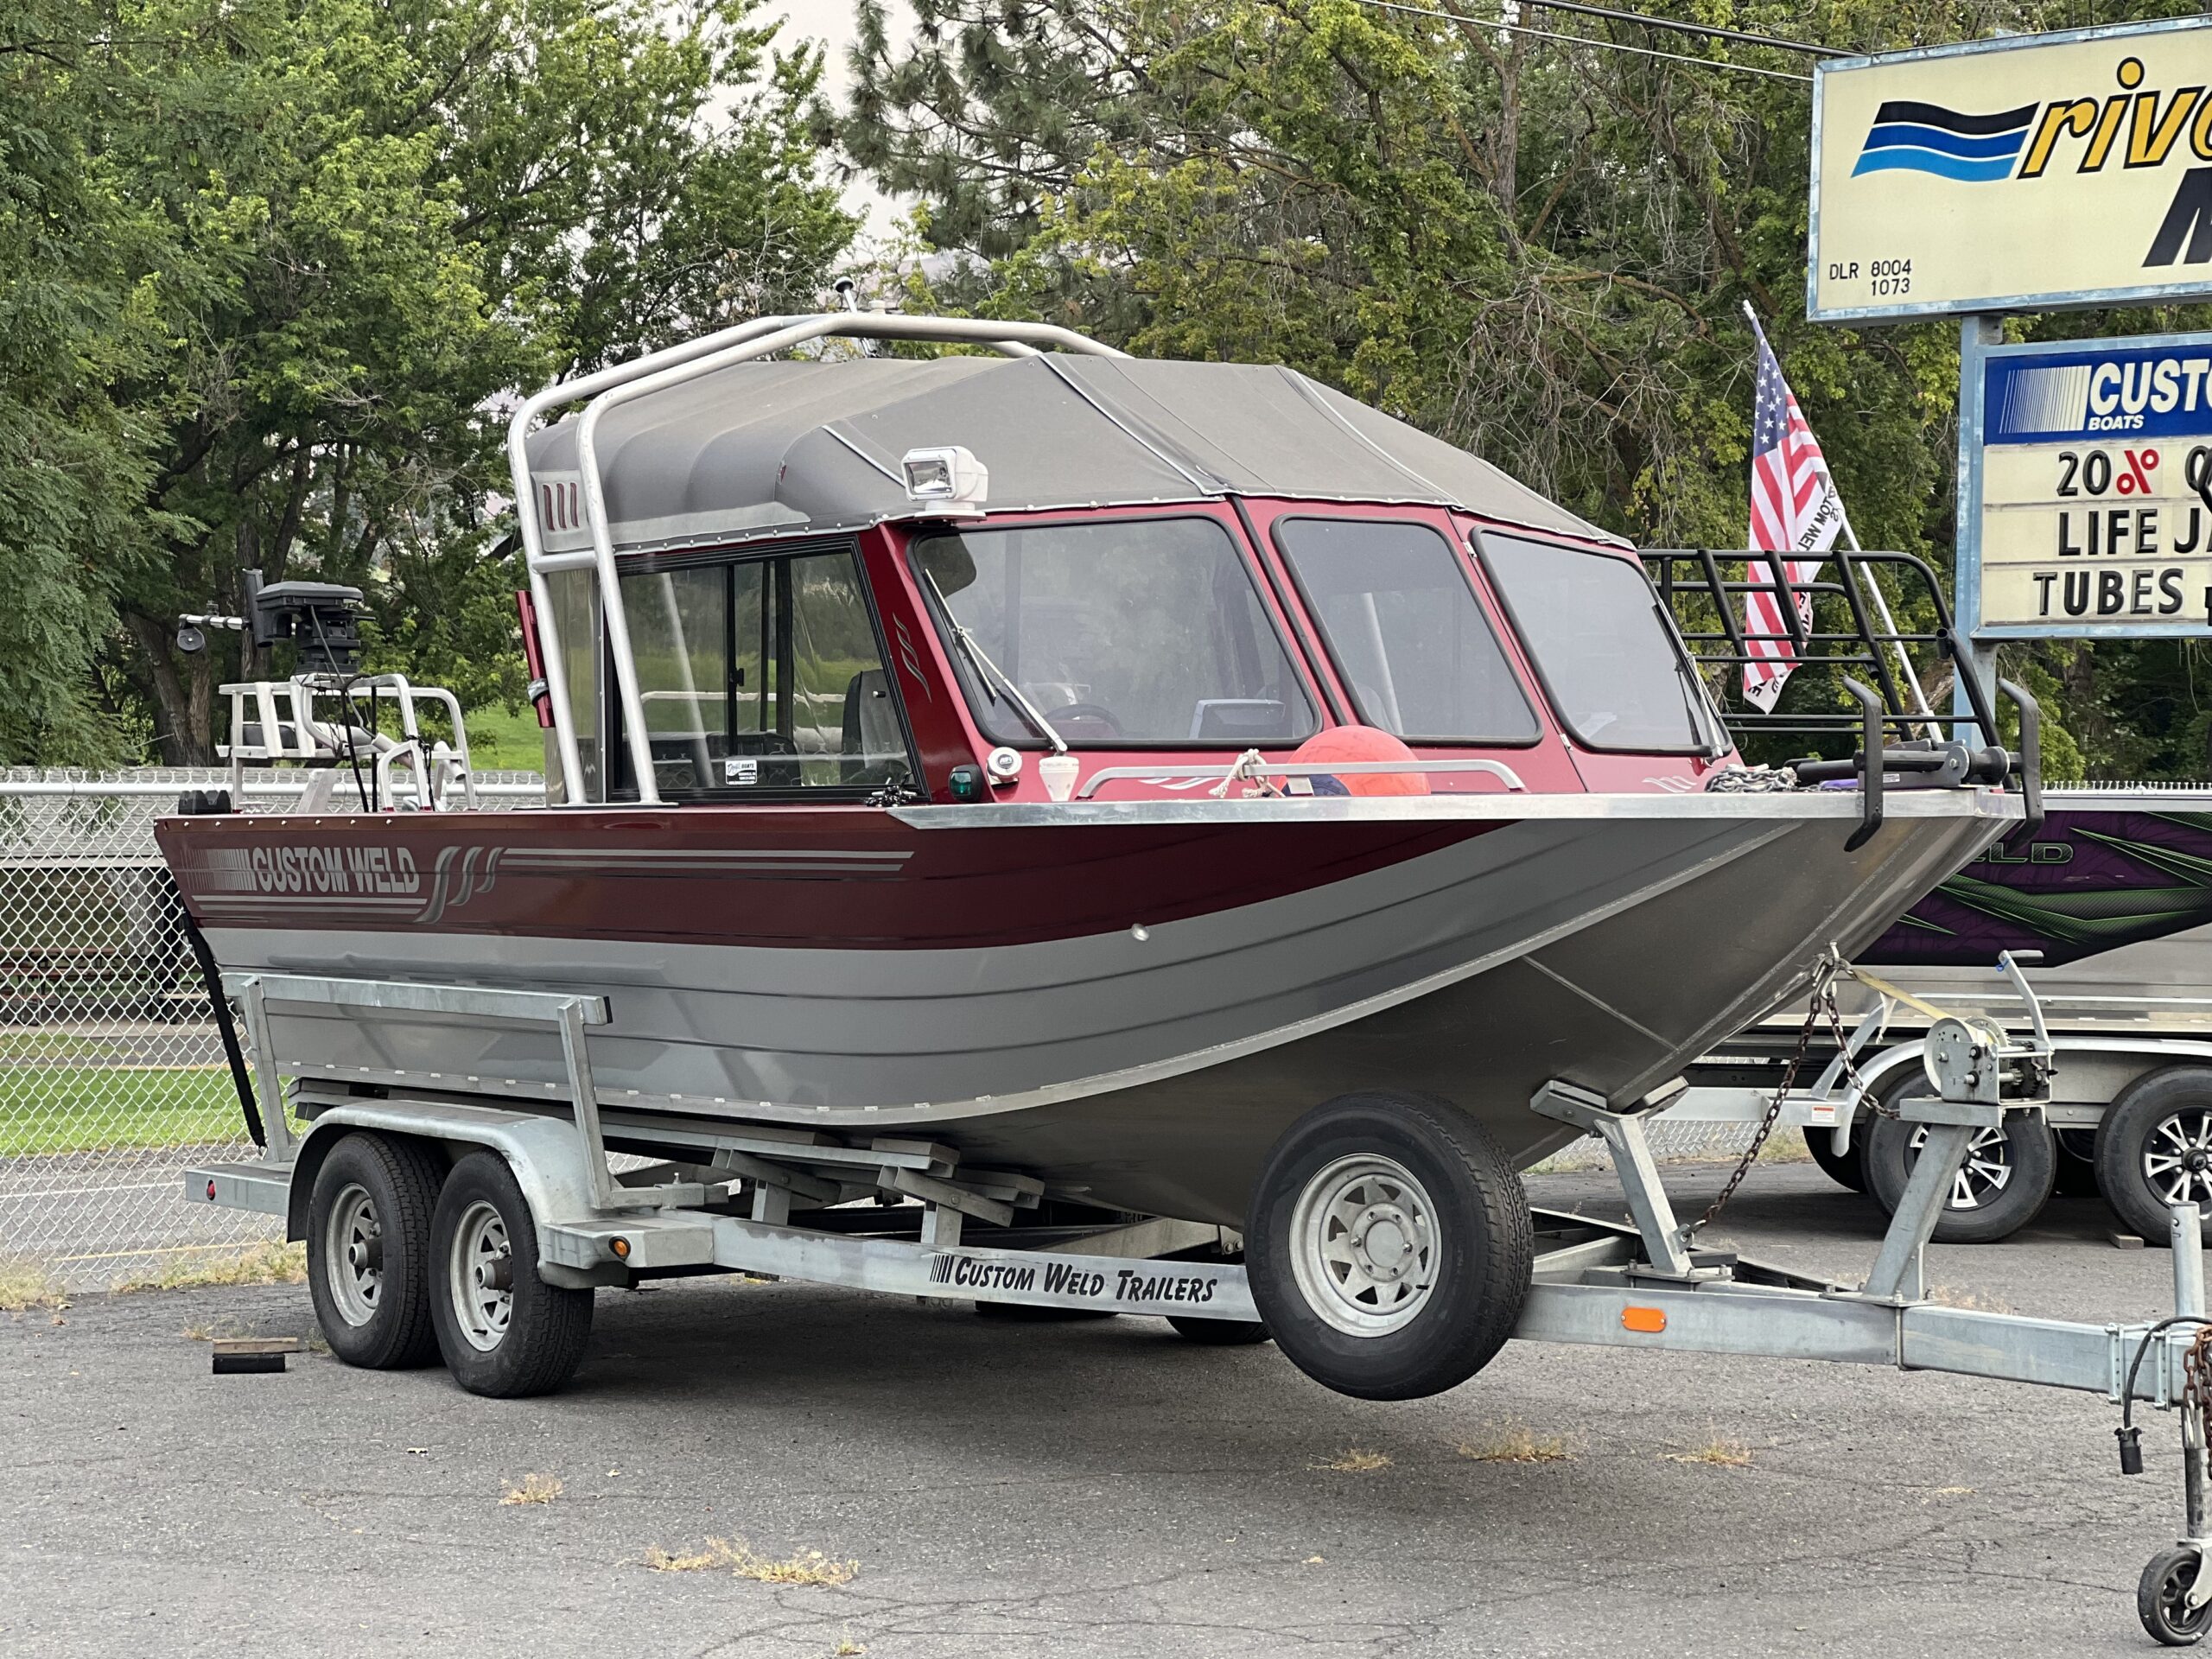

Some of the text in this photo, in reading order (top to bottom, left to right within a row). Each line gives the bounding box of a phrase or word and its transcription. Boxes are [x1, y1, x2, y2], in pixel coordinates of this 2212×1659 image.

[1829, 258, 1912, 280] DLR 8004
[1871, 277, 1910, 296] 1073
[2089, 359, 2212, 416] CUST
[2088, 415, 2145, 431] BOATS
[2056, 448, 2160, 497] 20%
[2058, 508, 2158, 556] LIFE
[2033, 568, 2184, 616] TUBES
[251, 846, 421, 893] CUSTOM WELD
